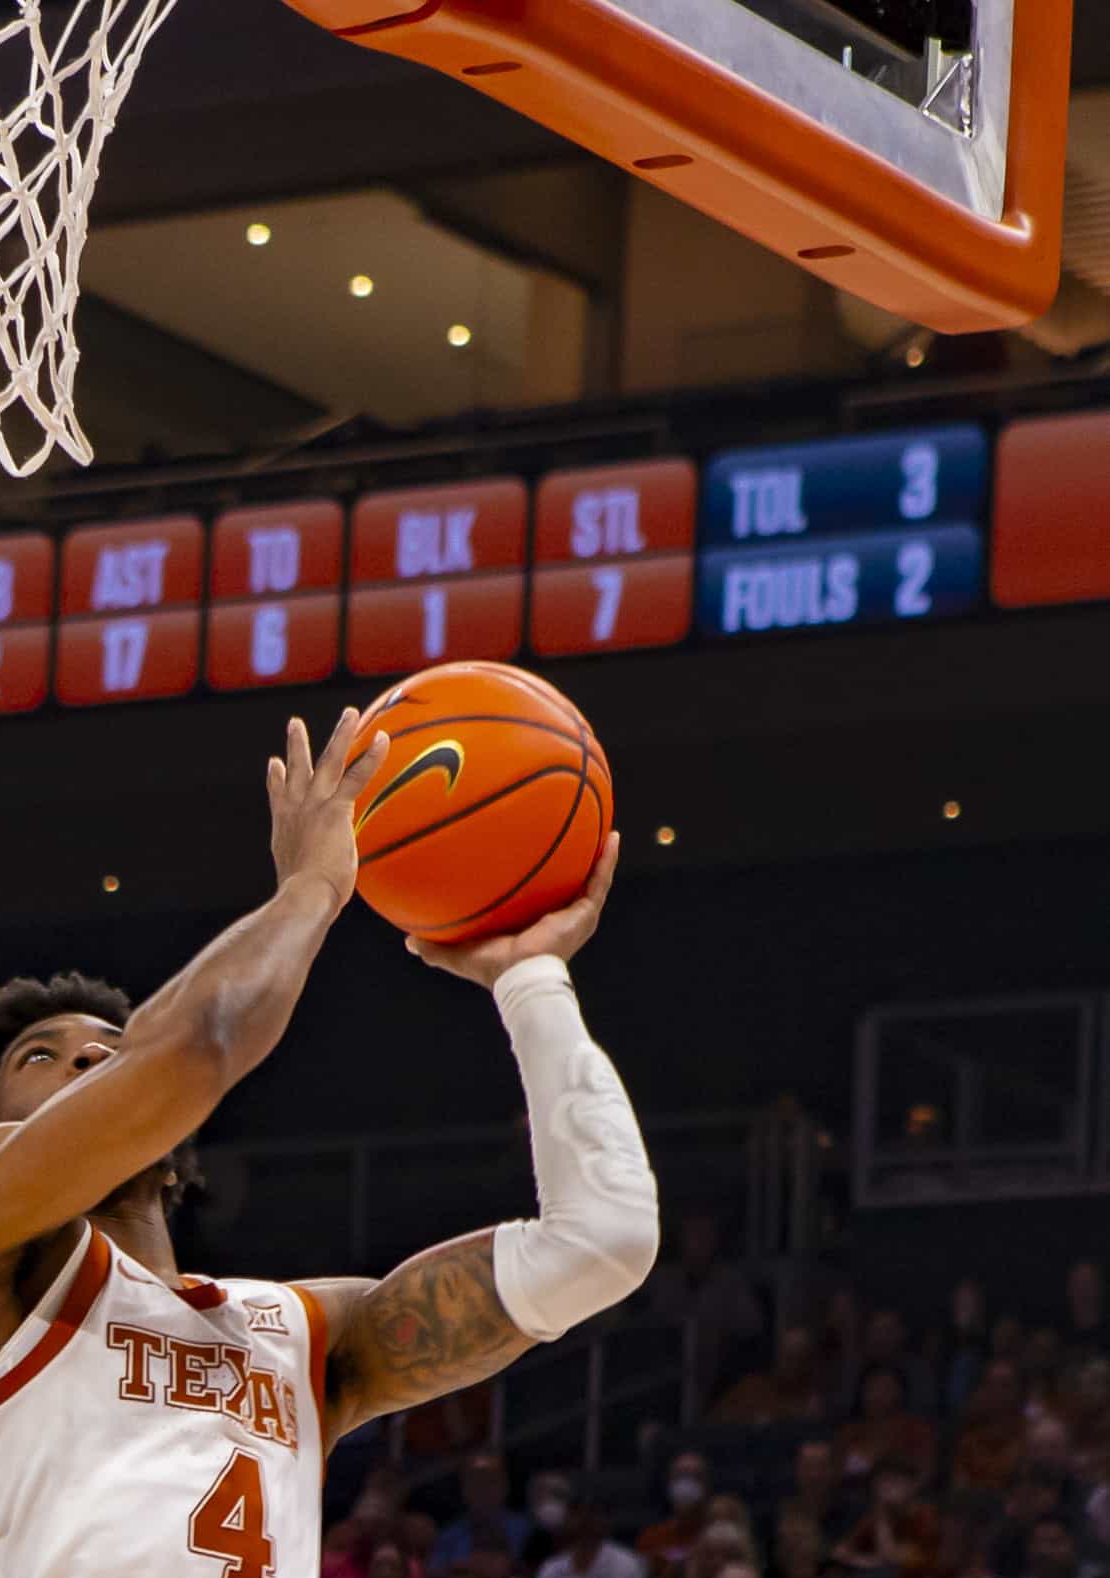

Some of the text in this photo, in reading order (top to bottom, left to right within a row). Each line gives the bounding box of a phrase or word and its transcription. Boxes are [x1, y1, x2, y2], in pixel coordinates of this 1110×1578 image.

[571, 487, 645, 558] STL
[730, 442, 938, 537] TOL 3
[92, 540, 170, 610] AST
[247, 526, 299, 592] TO
[397, 507, 475, 577] BLK
[422, 584, 446, 658] 1
[591, 566, 625, 641] 7
[722, 540, 933, 633] FOULS 2
[101, 617, 149, 691] 17
[107, 1321, 298, 1452] TEXAS
